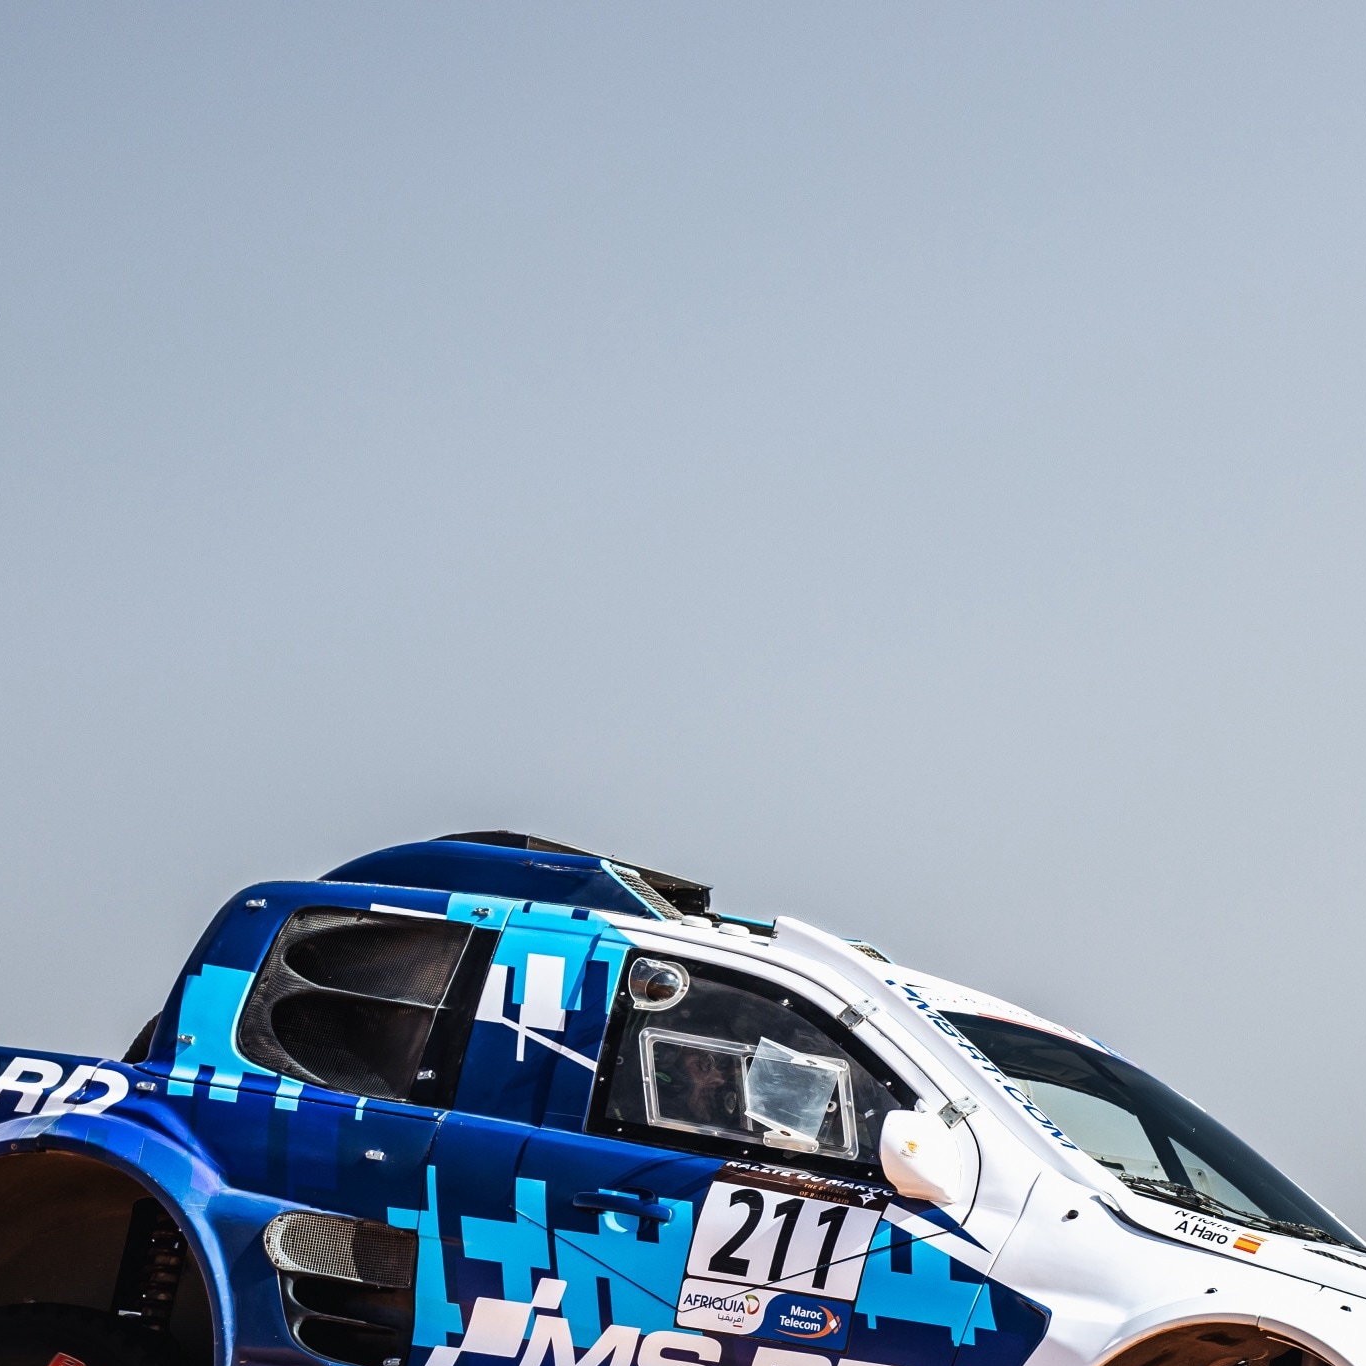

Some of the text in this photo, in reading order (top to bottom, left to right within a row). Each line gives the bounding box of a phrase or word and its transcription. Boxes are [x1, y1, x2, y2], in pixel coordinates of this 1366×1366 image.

[796, 1173, 826, 1185] DU
[825, 1178, 894, 1197] MAROC
[803, 1182, 818, 1190] THE
[708, 1188, 849, 1290] 211
[1174, 1220, 1229, 1245] A Haro
[683, 1293, 746, 1315] AFRIQUIA
[790, 1305, 823, 1321] Maroc
[779, 1315, 821, 1332] Telecom
